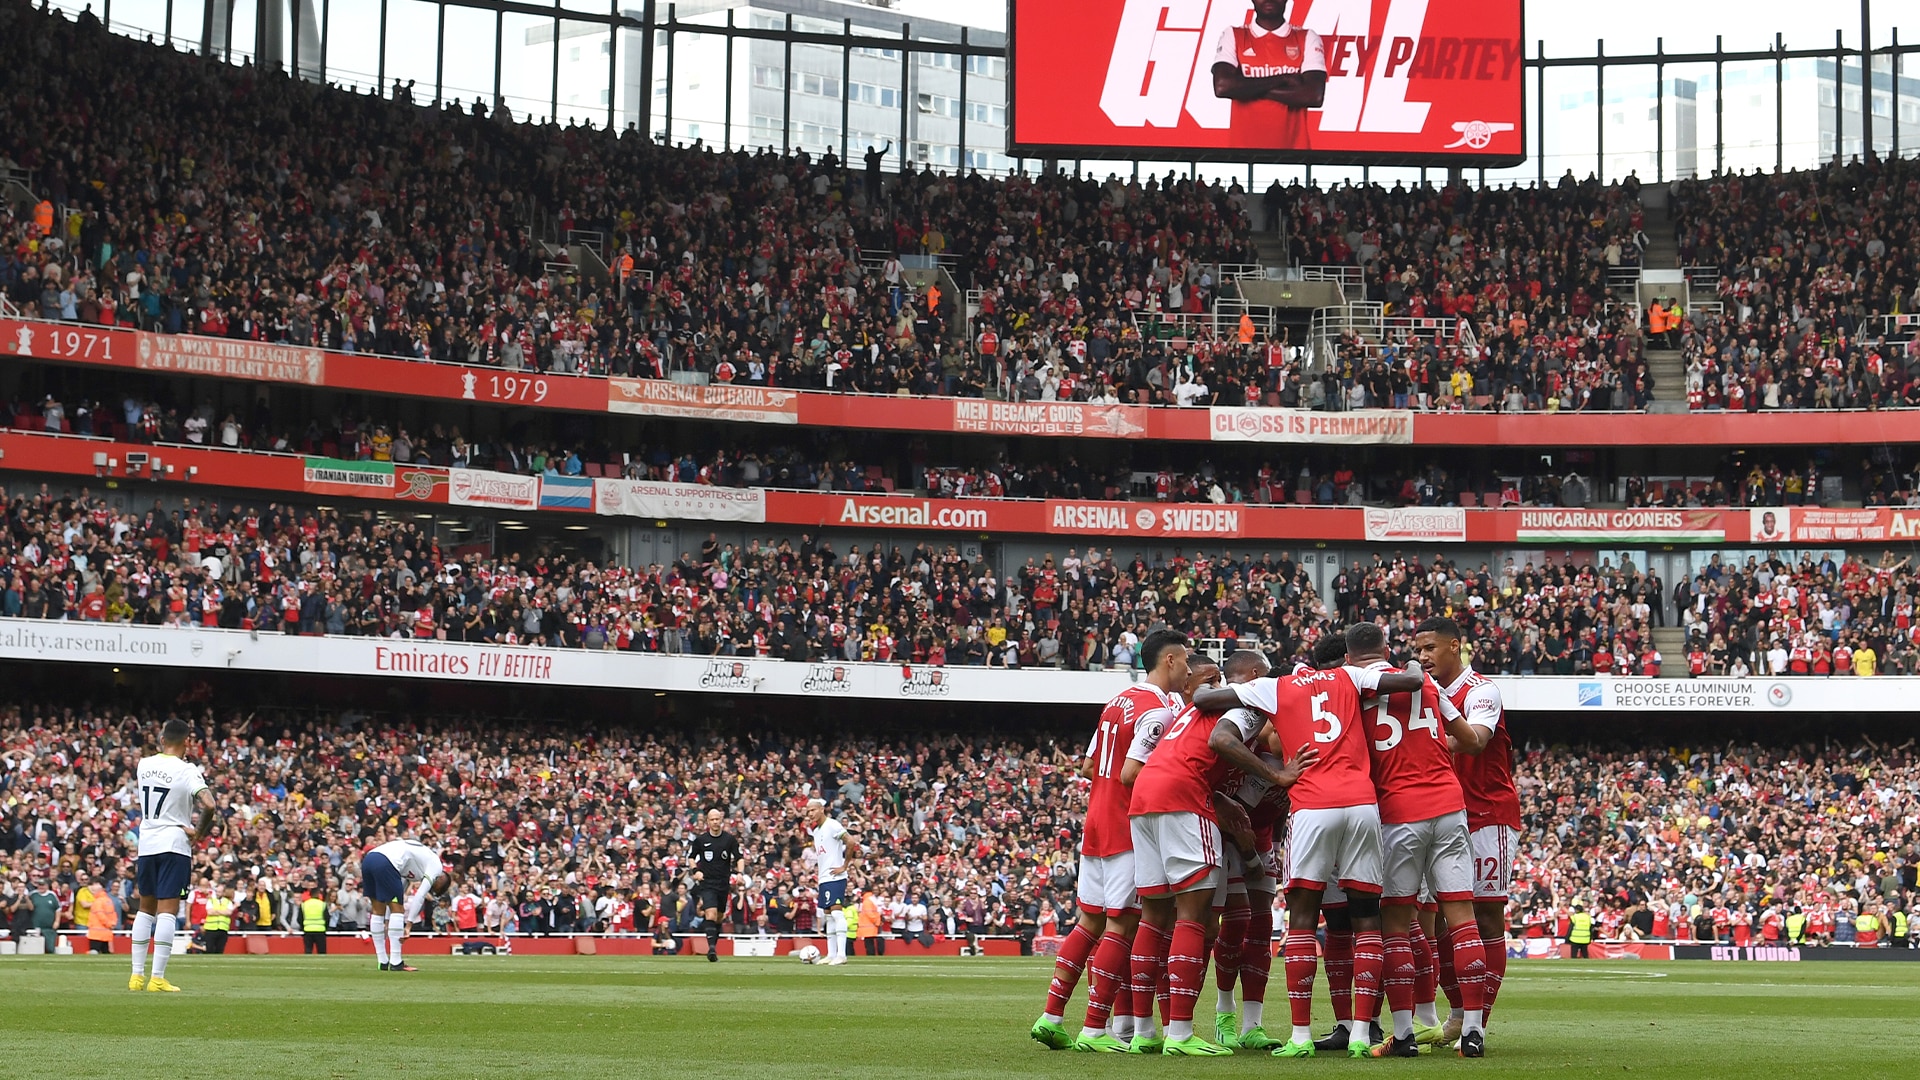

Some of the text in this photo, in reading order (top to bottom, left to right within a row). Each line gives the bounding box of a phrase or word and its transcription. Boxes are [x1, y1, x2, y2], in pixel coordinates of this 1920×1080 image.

[1384, 37, 1519, 80] PARTEY
[50, 331, 112, 360] 1971
[156, 337, 301, 364] WE WON THE LEAGUE
[153, 353, 302, 380] AT WHITE HART LANE
[490, 376, 548, 402] 1979
[643, 383, 765, 407] ARSENAL BULGARIA
[957, 402, 1083, 424] MEN BECAME GODS
[1289, 415, 1305, 434] IS
[1309, 417, 1408, 436] PERMANENT
[957, 420, 1083, 434] THE INVINCIBLES
[315, 470, 384, 485] IRANIAN GUNNERS
[473, 474, 534, 499] Arsenal
[631, 485, 759, 502] ARSENAL SUPPORTERS CLUB
[840, 498, 987, 528] Arsenal.com
[1053, 505, 1238, 532] ARSENAL SWEDEN
[1390, 510, 1463, 531] Arsenal
[1522, 511, 1683, 528] HUNGARIAN GOONERS
[966, 547, 976, 557] 45
[375, 646, 552, 679] Emirates FLY BETTER
[1614, 683, 1757, 694] CHOOSE ALUMINIUM.
[1616, 696, 1755, 707] RECYCLES FOREVER.
[1310, 691, 1342, 743] 5
[1363, 689, 1439, 752] 34
[1099, 720, 1118, 779] 11
[140, 770, 173, 784] ROMERO
[142, 785, 171, 820] 17
[1474, 856, 1499, 882] 12
[824, 890, 831, 902] 9
